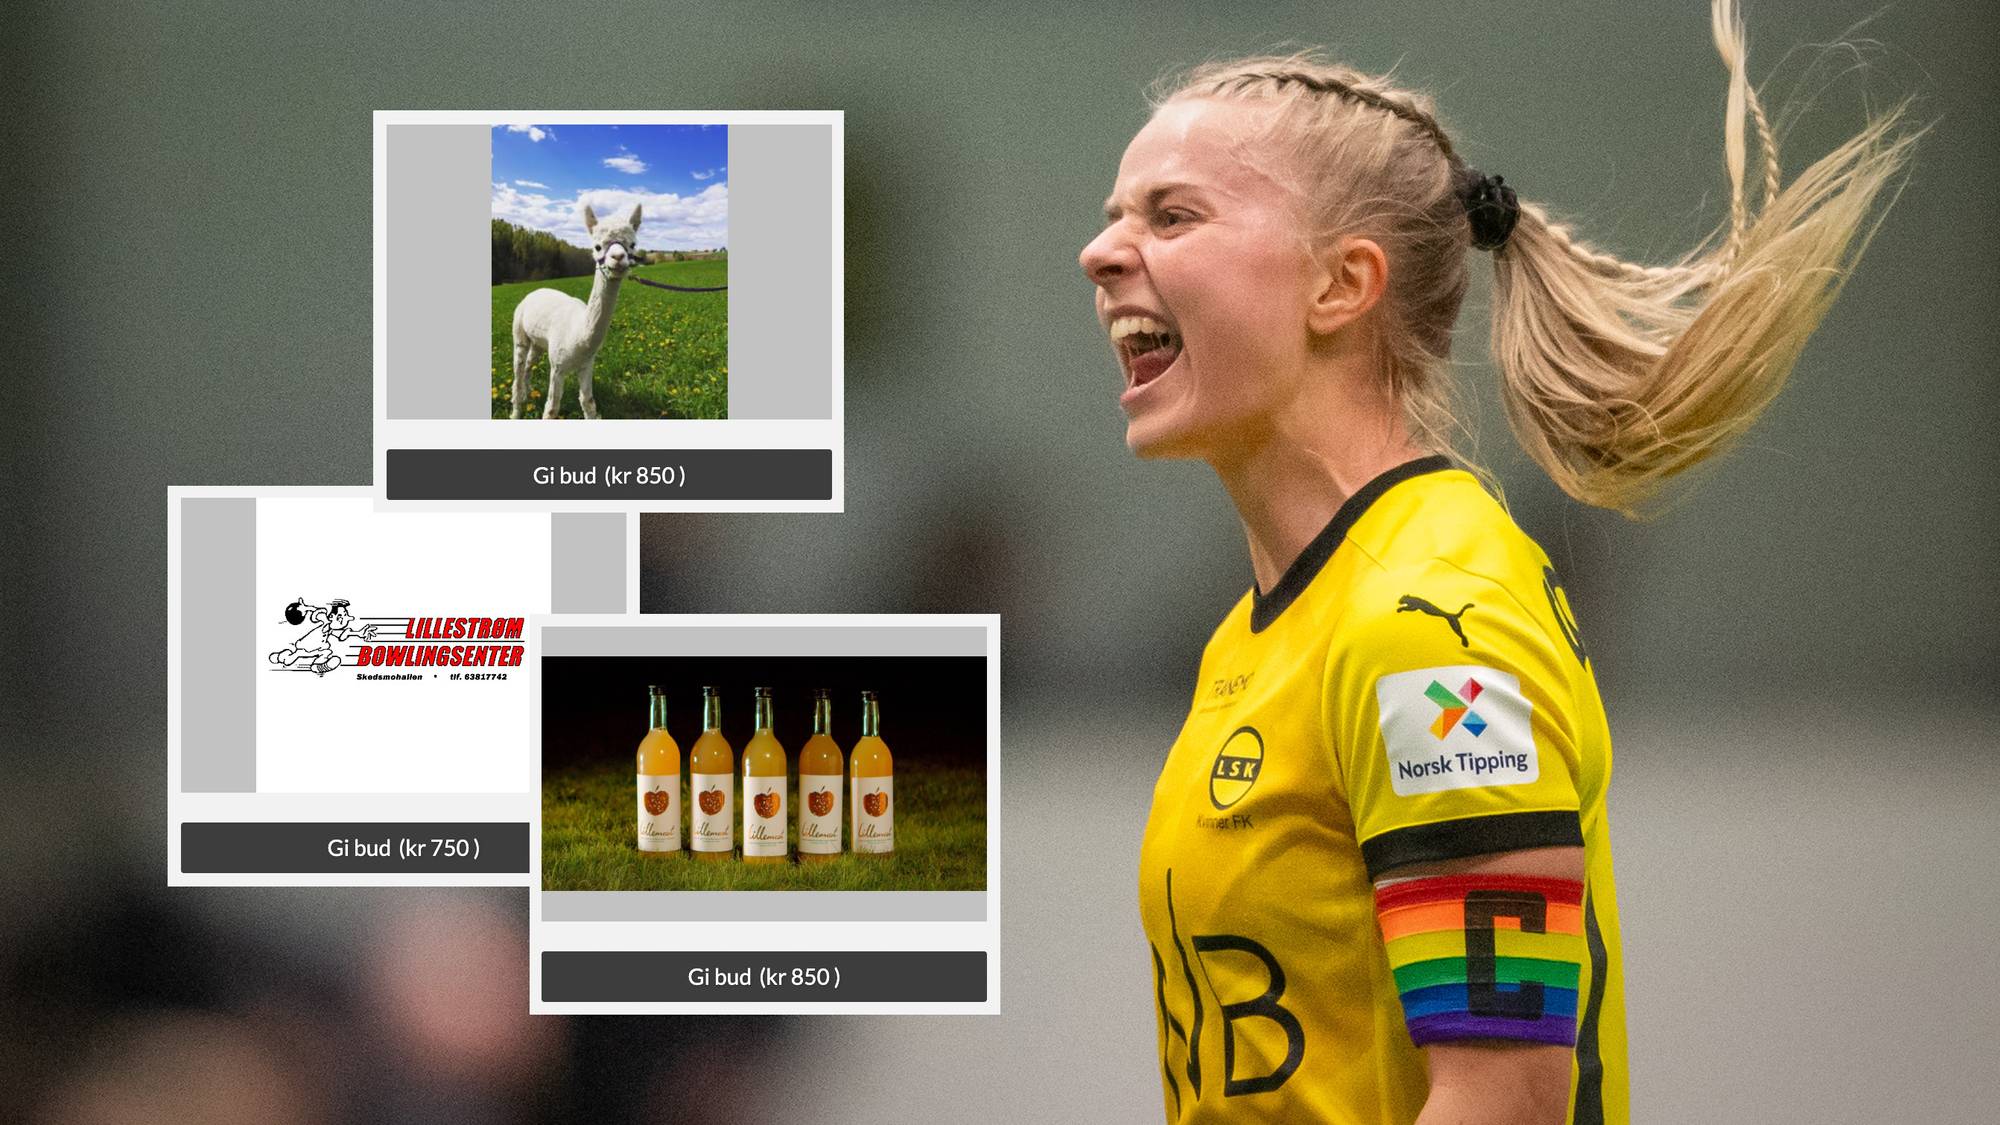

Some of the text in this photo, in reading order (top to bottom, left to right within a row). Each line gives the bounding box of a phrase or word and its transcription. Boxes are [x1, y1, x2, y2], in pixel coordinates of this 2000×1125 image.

[1216, 759, 1256, 778] LSK
[1398, 750, 1528, 780] Norsk Tipping
[1232, 814, 1254, 830] FK
[1464, 889, 1547, 1021] C
